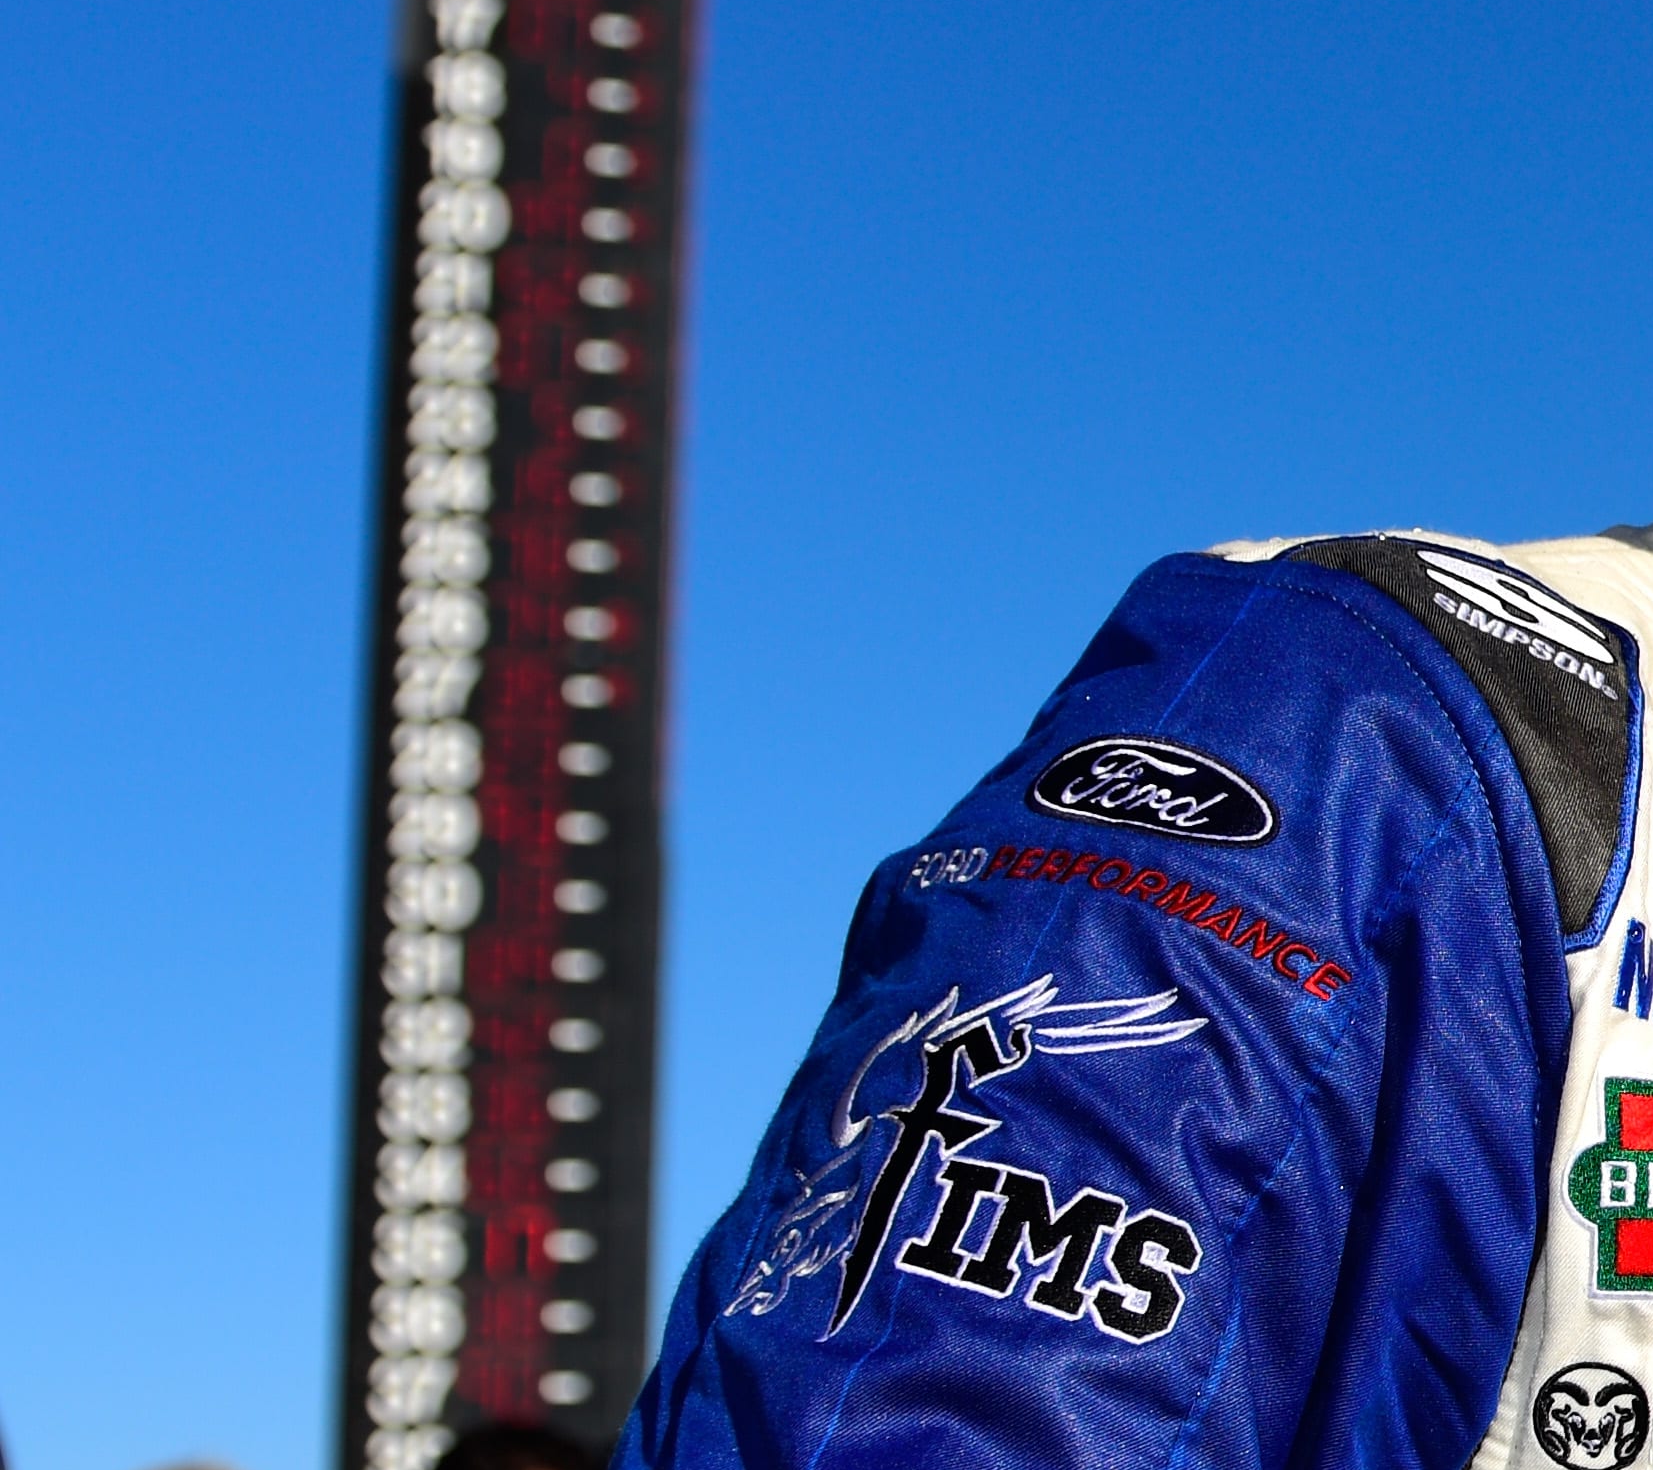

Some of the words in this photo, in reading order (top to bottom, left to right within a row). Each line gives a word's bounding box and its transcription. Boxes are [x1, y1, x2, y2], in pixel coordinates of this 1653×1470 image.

[1433, 592, 1605, 690] SIMPSON
[1064, 743, 1230, 830] Ford
[903, 846, 987, 893] FORD
[984, 845, 1353, 1002] PERFORMANCE
